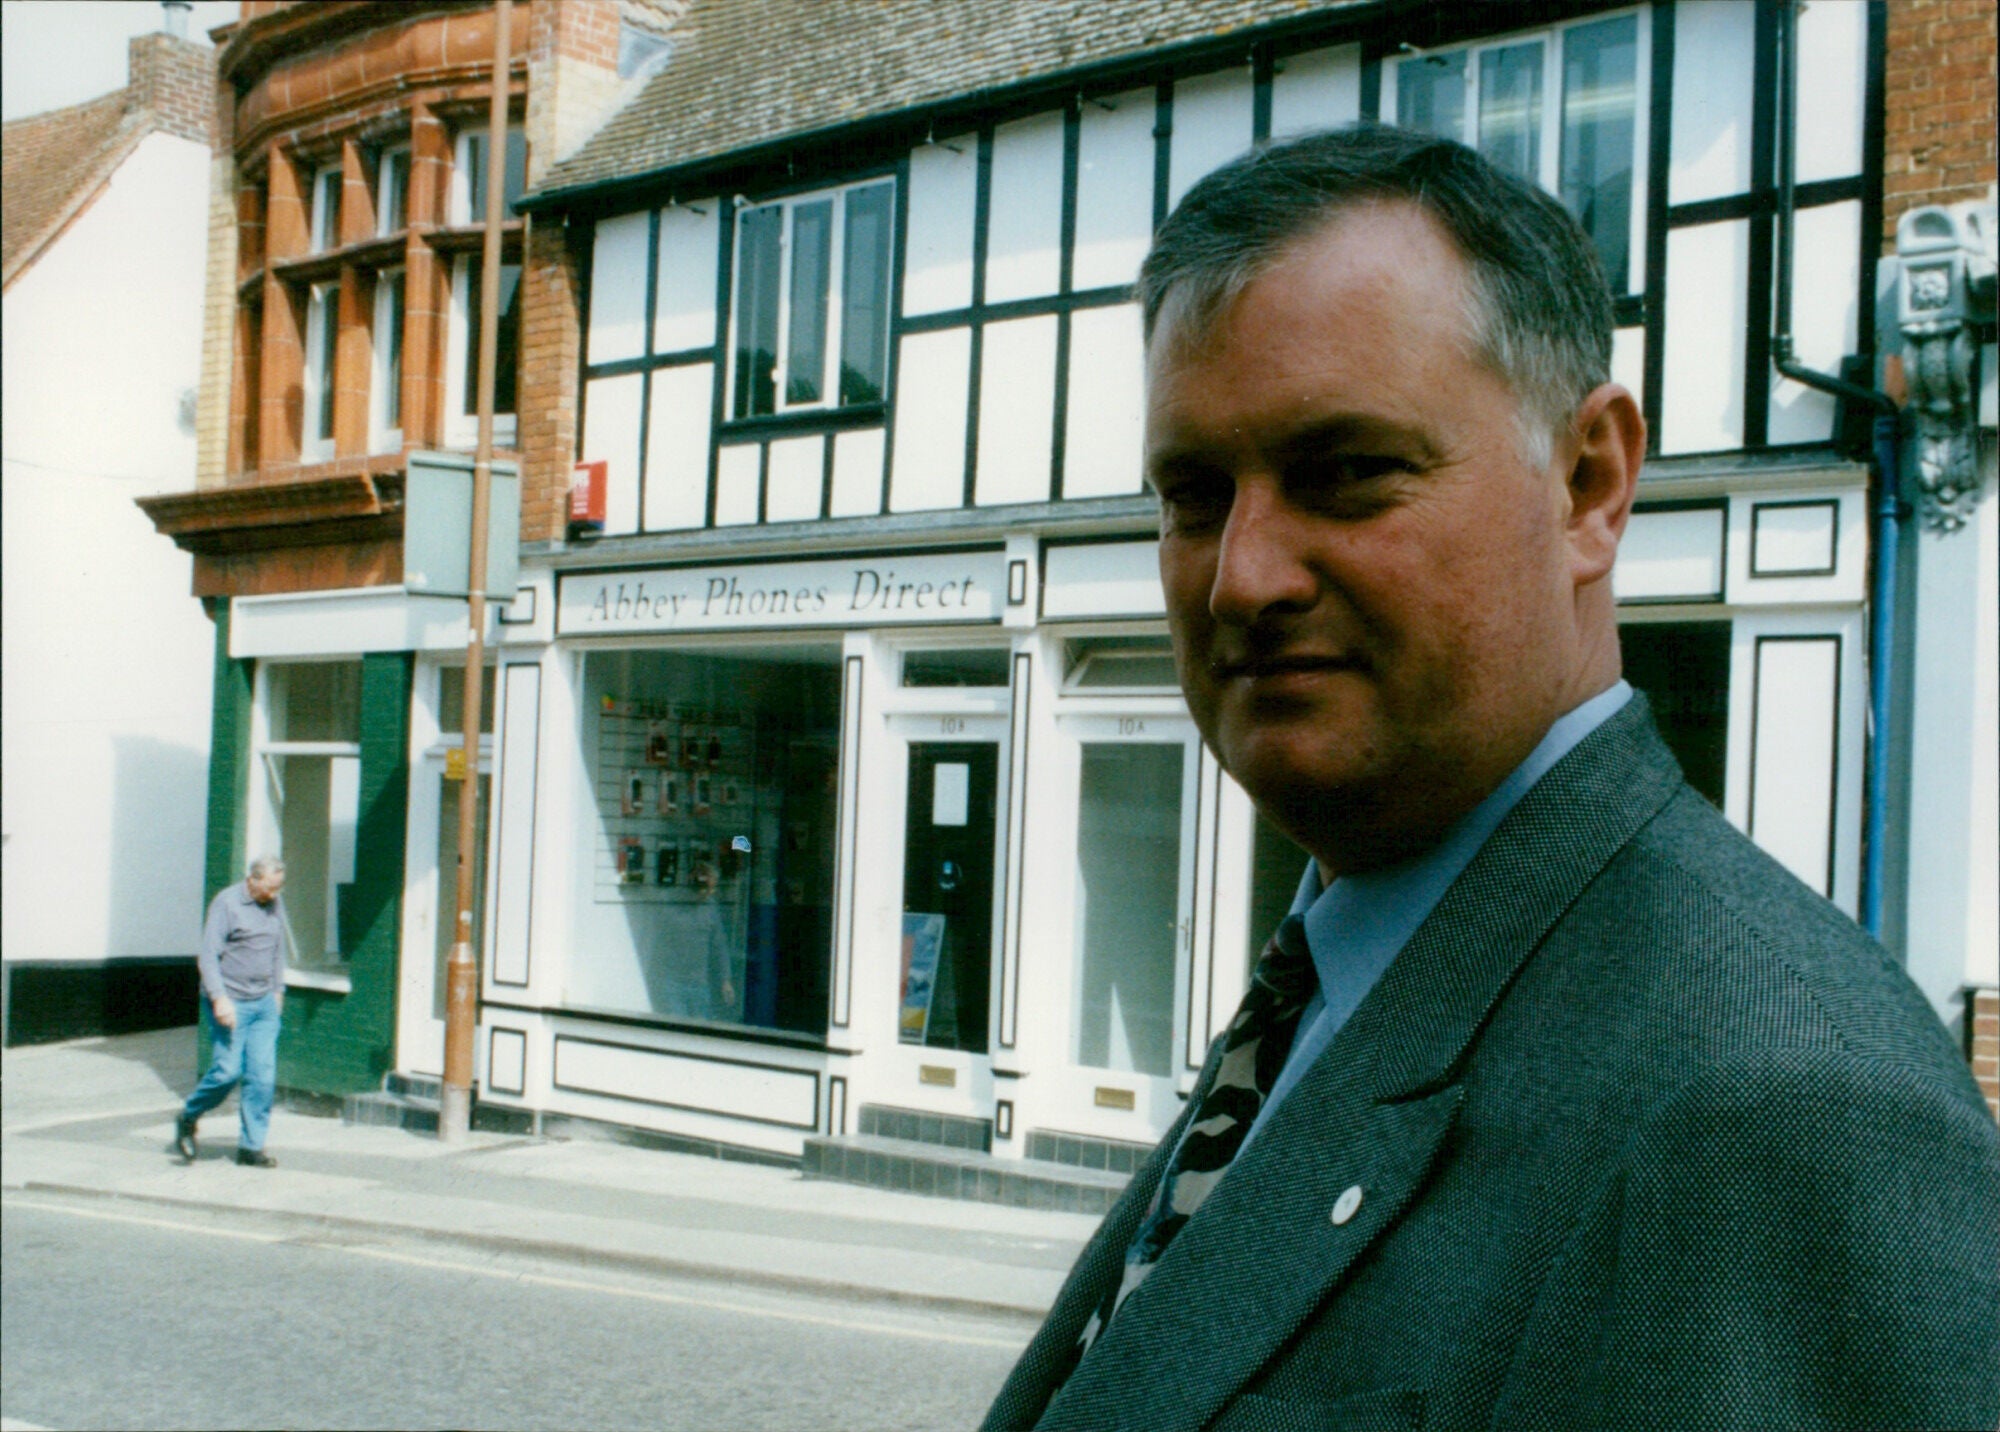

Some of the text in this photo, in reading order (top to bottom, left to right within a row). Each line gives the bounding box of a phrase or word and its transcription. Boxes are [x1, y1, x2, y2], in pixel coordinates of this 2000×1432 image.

[588, 569, 974, 627] Abbey Phones Direct
